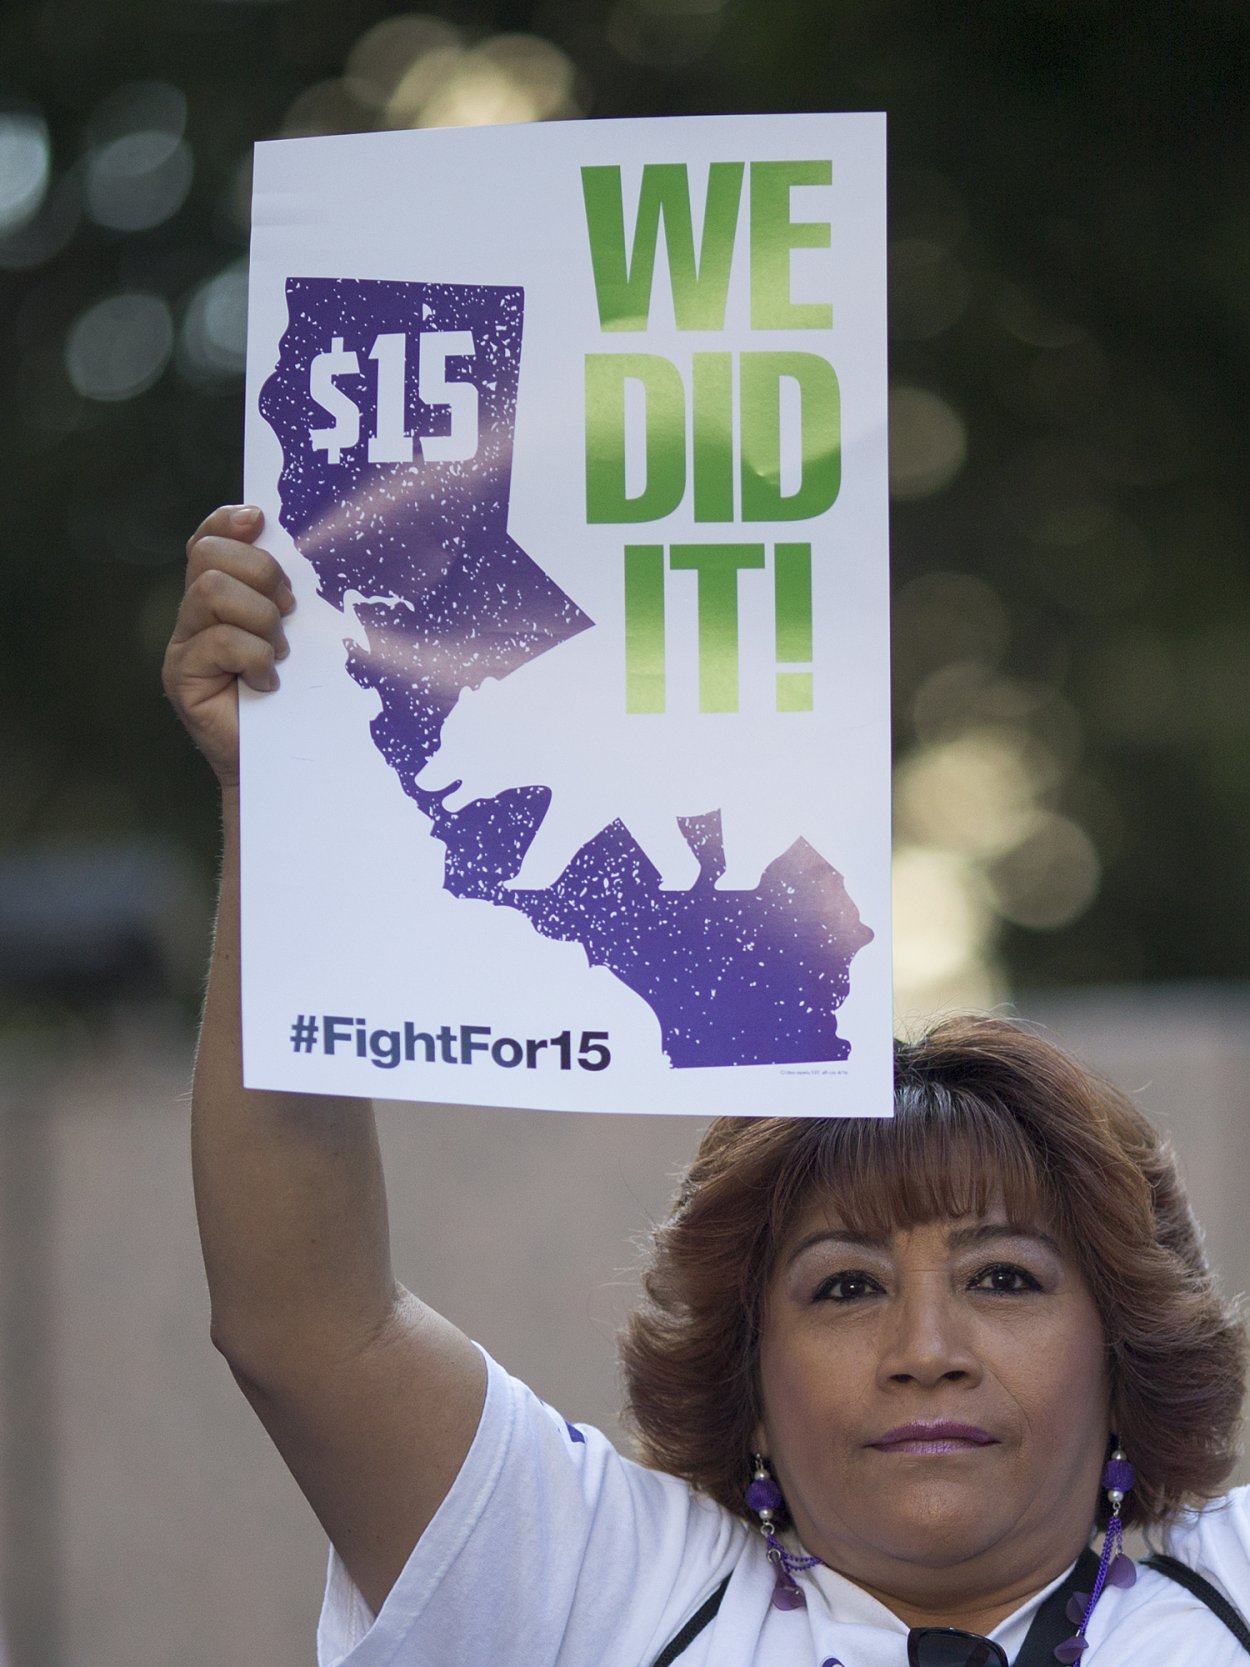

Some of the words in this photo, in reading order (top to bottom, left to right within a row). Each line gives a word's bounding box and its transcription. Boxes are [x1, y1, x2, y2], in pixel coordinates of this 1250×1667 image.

[580, 160, 832, 332] WE
[309, 330, 478, 464] $15
[585, 351, 841, 524] DID
[624, 542, 813, 714] IT!
[290, 1014, 611, 1071] #FightFor15
